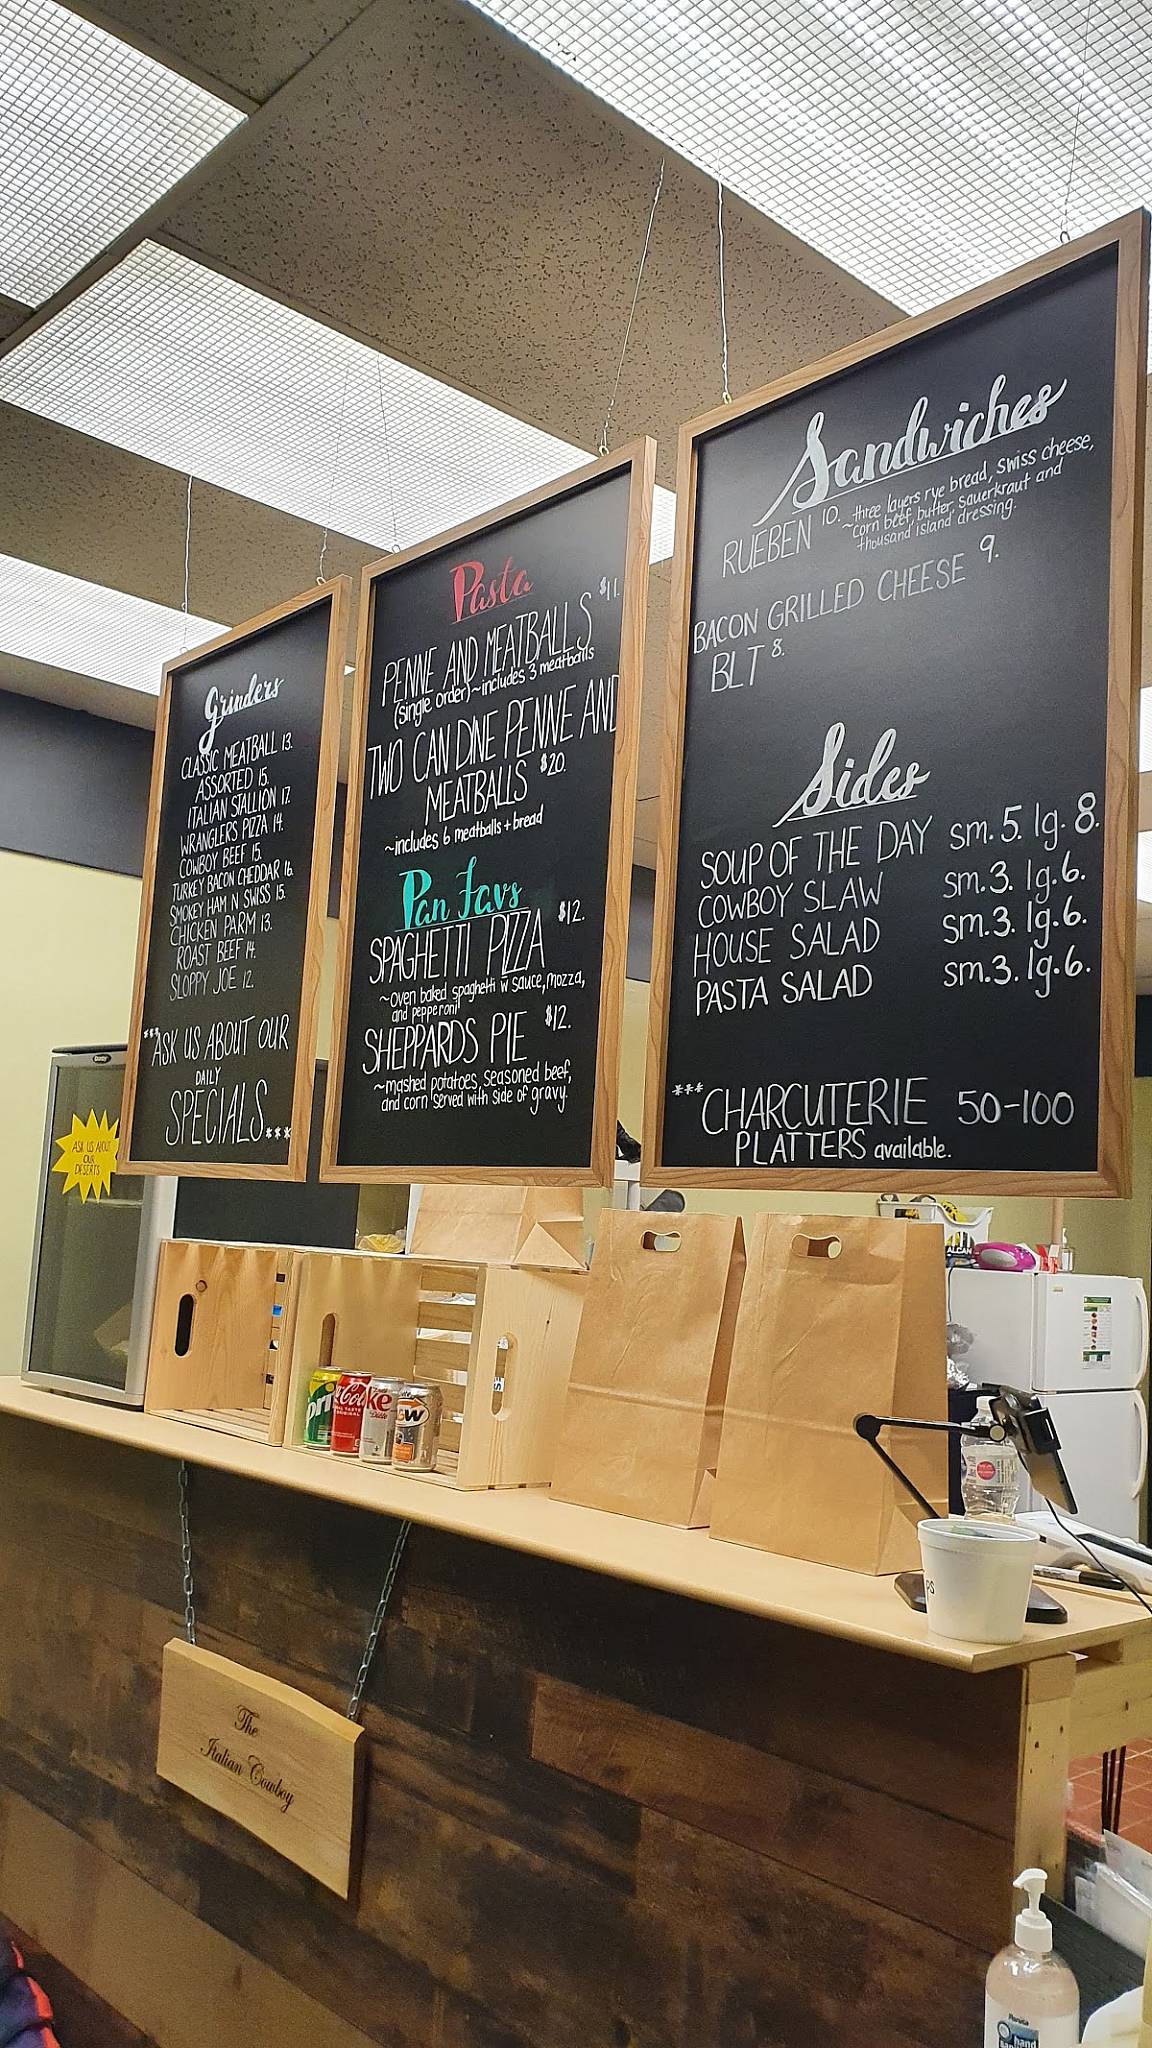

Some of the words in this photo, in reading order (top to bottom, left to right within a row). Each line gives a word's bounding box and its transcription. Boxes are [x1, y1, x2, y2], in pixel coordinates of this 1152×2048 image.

[752, 374, 1067, 527] Sandwiches
[888, 490, 921, 515] layers
[925, 486, 945, 504] rye
[950, 462, 993, 492] bread,
[1041, 434, 1094, 461] cheese,
[959, 474, 1030, 509] sauerkraut
[1036, 458, 1064, 483] and
[721, 515, 812, 579] RUEBEN
[822, 506, 840, 526] 10.
[856, 530, 911, 551] thousand
[916, 516, 951, 537] island
[958, 498, 1017, 525] dressing.
[450, 556, 535, 621] Pasta
[692, 609, 759, 654] BACON
[767, 578, 865, 632] GRILLED
[877, 553, 966, 601] CHEESE
[980, 534, 1000, 563] 9.
[381, 646, 438, 707] PENNE
[443, 636, 478, 689] AND
[484, 592, 592, 676] MEATBALLS
[711, 645, 765, 693] BLT
[771, 638, 785, 658] 8.
[199, 673, 284, 754] Grinders
[394, 698, 432, 729] (single
[530, 664, 537, 680] 3
[540, 647, 595, 676] meatballs
[181, 750, 219, 779] CLASSIC
[224, 731, 278, 770] MEATBALL
[282, 732, 293, 750] 13.
[368, 738, 403, 800] TWO
[413, 724, 450, 783] CAN
[505, 684, 577, 759] PENNE
[580, 674, 620, 739] AND
[195, 767, 253, 803] ASSORTED
[258, 767, 269, 786] 15.
[425, 760, 528, 826] MEATBALLS
[540, 752, 567, 776] $20.
[772, 722, 931, 828] Sides
[188, 798, 228, 829] ITALIAN
[231, 786, 277, 817] STALLION
[281, 787, 291, 805] 17.
[443, 827, 450, 844] 6
[455, 819, 501, 843] meatballs
[513, 804, 544, 831] bread
[179, 851, 218, 878] COWBOY
[222, 843, 247, 868] BEEF
[252, 842, 262, 861] 15.
[180, 821, 238, 857] WRANGLERS
[242, 814, 268, 840] PIZZA
[273, 812, 283, 832] 14.
[700, 843, 763, 889] SOUP
[770, 836, 802, 880] OF
[813, 826, 863, 874] THE
[877, 816, 933, 864] DAY
[170, 902, 204, 927] SMOKEY
[207, 896, 227, 917] HAM
[232, 893, 238, 910] N
[243, 883, 271, 908] SWISS
[276, 884, 286, 900] 15.
[172, 877, 205, 902] TURKEY
[208, 871, 234, 893] BACON
[238, 859, 280, 886] CHEDDAR
[284, 860, 293, 877] 16.
[399, 869, 451, 929] Pan
[456, 856, 523, 919] Favs
[698, 884, 794, 929] COWBOY
[804, 872, 883, 913] SLAW
[170, 919, 218, 946] CHICKEN
[224, 911, 256, 937] PARM
[261, 912, 272, 932] 13.
[176, 943, 212, 970] ROAST
[217, 938, 244, 962] BEEF
[246, 941, 256, 959] 14.
[369, 922, 471, 984] SPAGHETTI
[487, 908, 545, 975] PIZZA
[558, 900, 585, 924] $12.
[693, 929, 774, 978] HOUSE
[790, 917, 880, 961] SALAD
[170, 971, 210, 1001] SLOPPY
[213, 966, 237, 994] JOE
[242, 970, 254, 989] 12.
[420, 985, 447, 1002] baked
[452, 978, 496, 1009] spaghetti
[512, 976, 545, 994] sauce,
[547, 971, 585, 988] mozza,
[696, 977, 768, 1016] PASTA
[782, 964, 873, 1004] SALAD
[184, 1026, 200, 1060] US
[204, 1016, 256, 1061] ABOUT
[258, 1014, 289, 1050] OUR
[363, 1018, 478, 1074] SHEPPARDS
[491, 1011, 528, 1064] PIE
[545, 1004, 571, 1031] $12.
[392, 1009, 407, 1023] and
[412, 1003, 458, 1024] pepperoni
[196, 1067, 221, 1085] DAILY
[382, 1097, 400, 1112] and
[404, 1094, 428, 1110] corn
[433, 1091, 463, 1110] served
[468, 1089, 488, 1107] with
[493, 1087, 513, 1104] side
[517, 1085, 528, 1102] of
[530, 1082, 568, 1115] gravy.
[484, 1061, 539, 1087] seasoned
[545, 1059, 571, 1084] beef,
[958, 1089, 1075, 1126] 50-100
[735, 1128, 866, 1166] PLATTERS
[873, 1136, 951, 1161] available.
[234, 1704, 260, 1738] The
[201, 1738, 244, 1776] Italian
[248, 1755, 294, 1813] Cowboy
